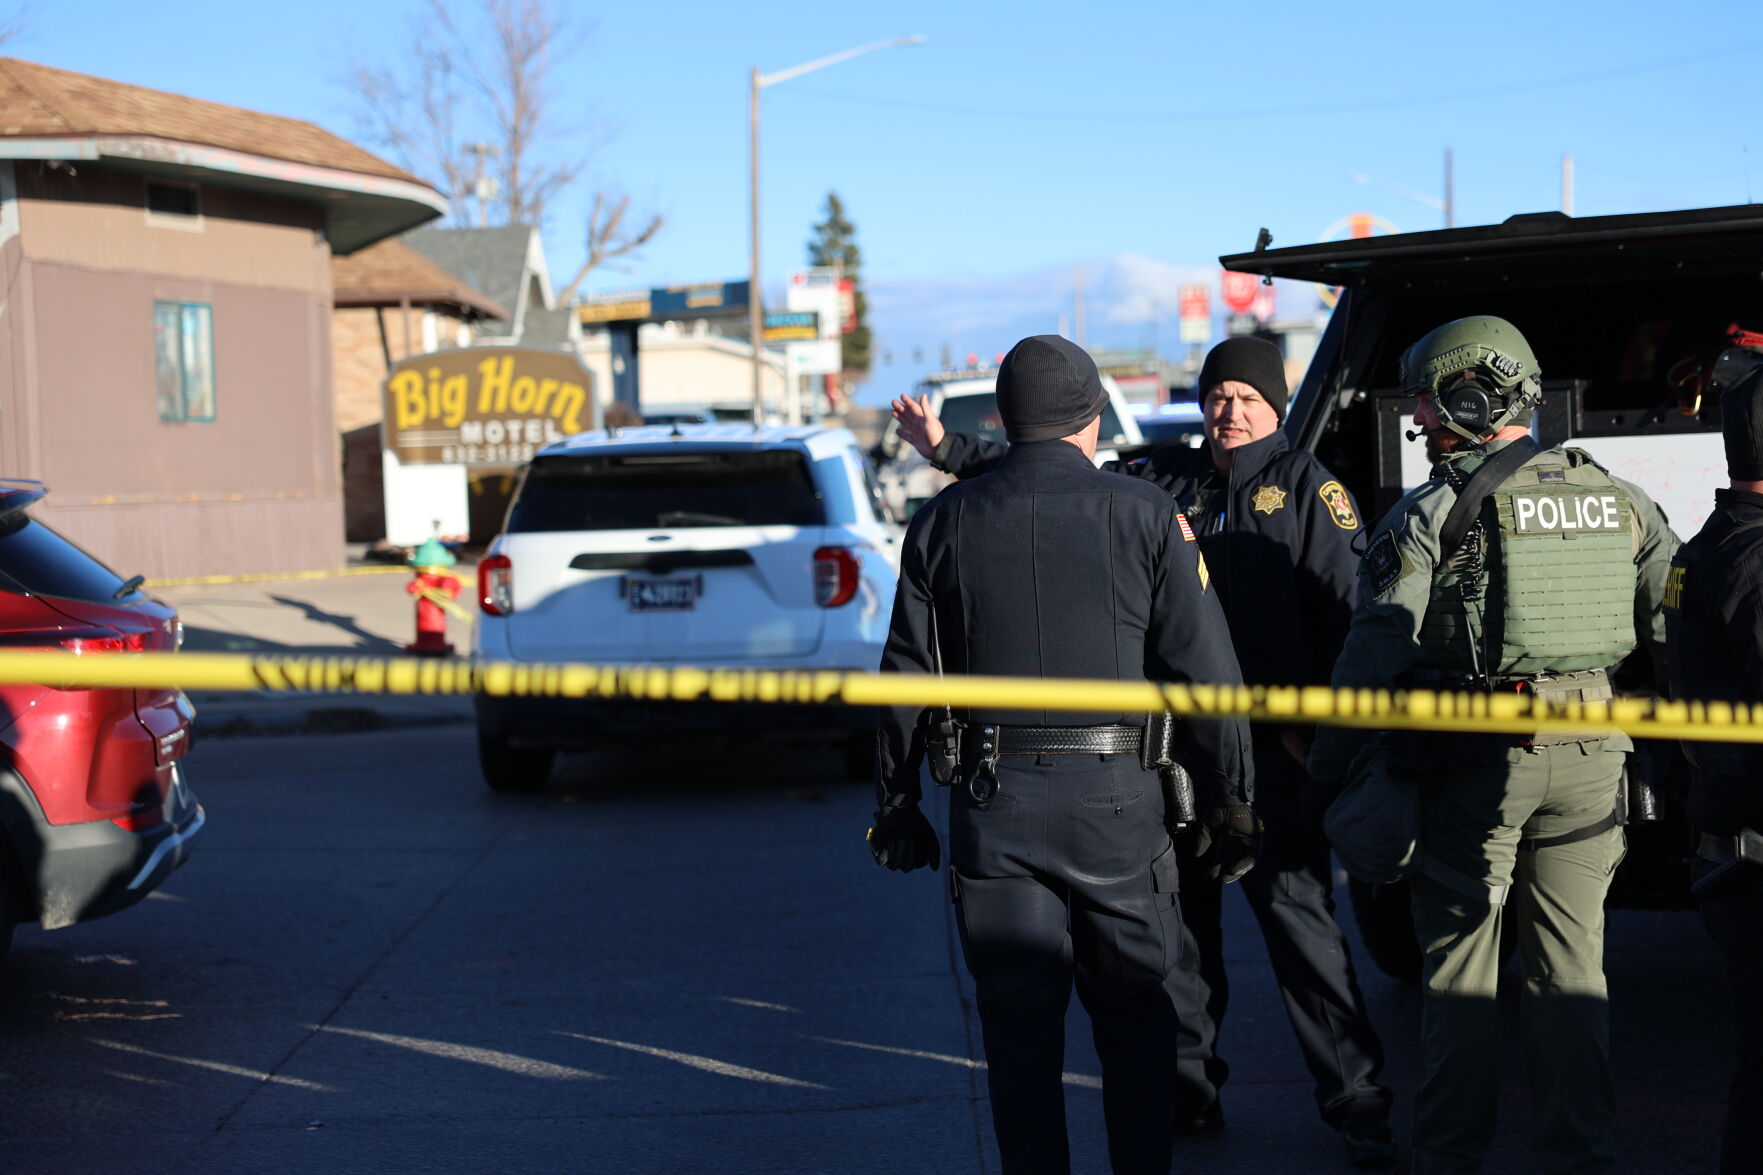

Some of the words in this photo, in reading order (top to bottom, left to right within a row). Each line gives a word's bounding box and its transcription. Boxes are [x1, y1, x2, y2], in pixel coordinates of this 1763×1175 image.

[389, 366, 468, 430] Big
[477, 354, 586, 435] Horn
[459, 418, 562, 444] MOTEL
[1516, 496, 1620, 530] POLICE
